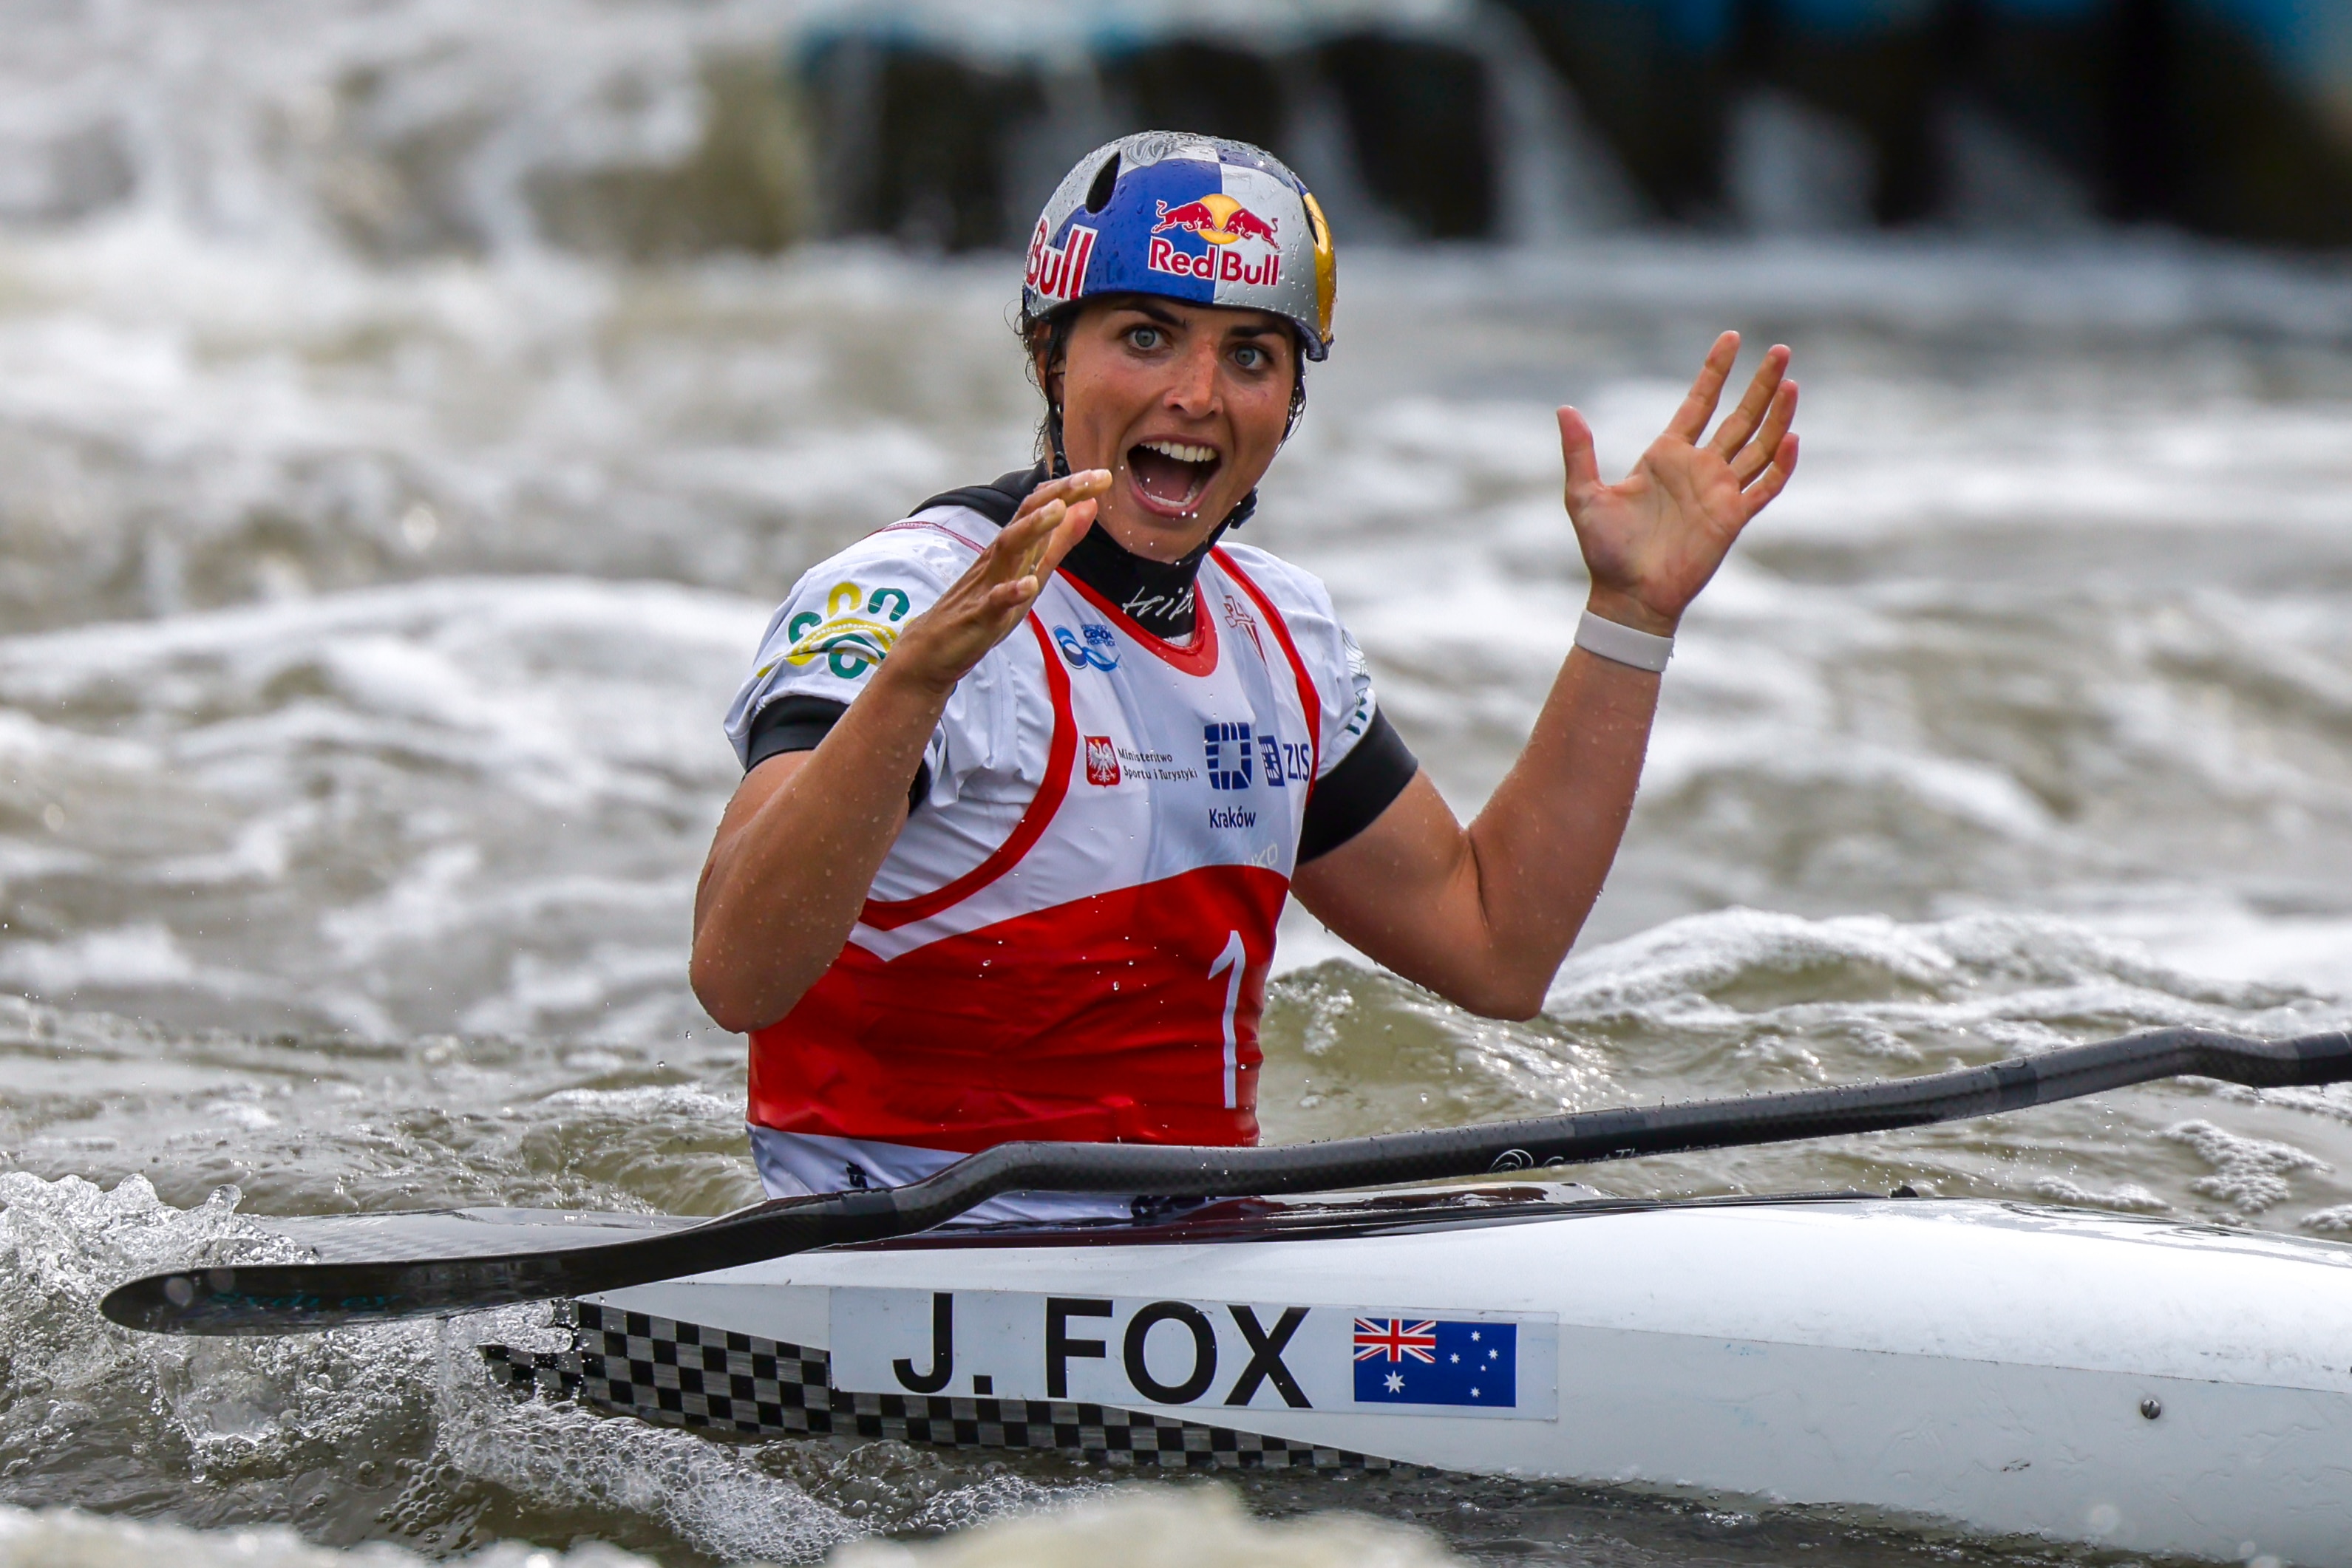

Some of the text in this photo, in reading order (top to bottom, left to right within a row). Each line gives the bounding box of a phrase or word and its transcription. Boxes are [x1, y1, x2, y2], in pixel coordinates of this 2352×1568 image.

[1025, 217, 1094, 300] Bull
[1149, 237, 1279, 287] Red Bull
[1124, 765, 1152, 780] Sportu
[1158, 767, 1198, 782] Turystyki
[1282, 743, 1311, 783] ZIS
[1209, 805, 1257, 828] Kraków
[1208, 930, 1245, 1108] 1
[892, 1292, 1313, 1408] J. FOX
